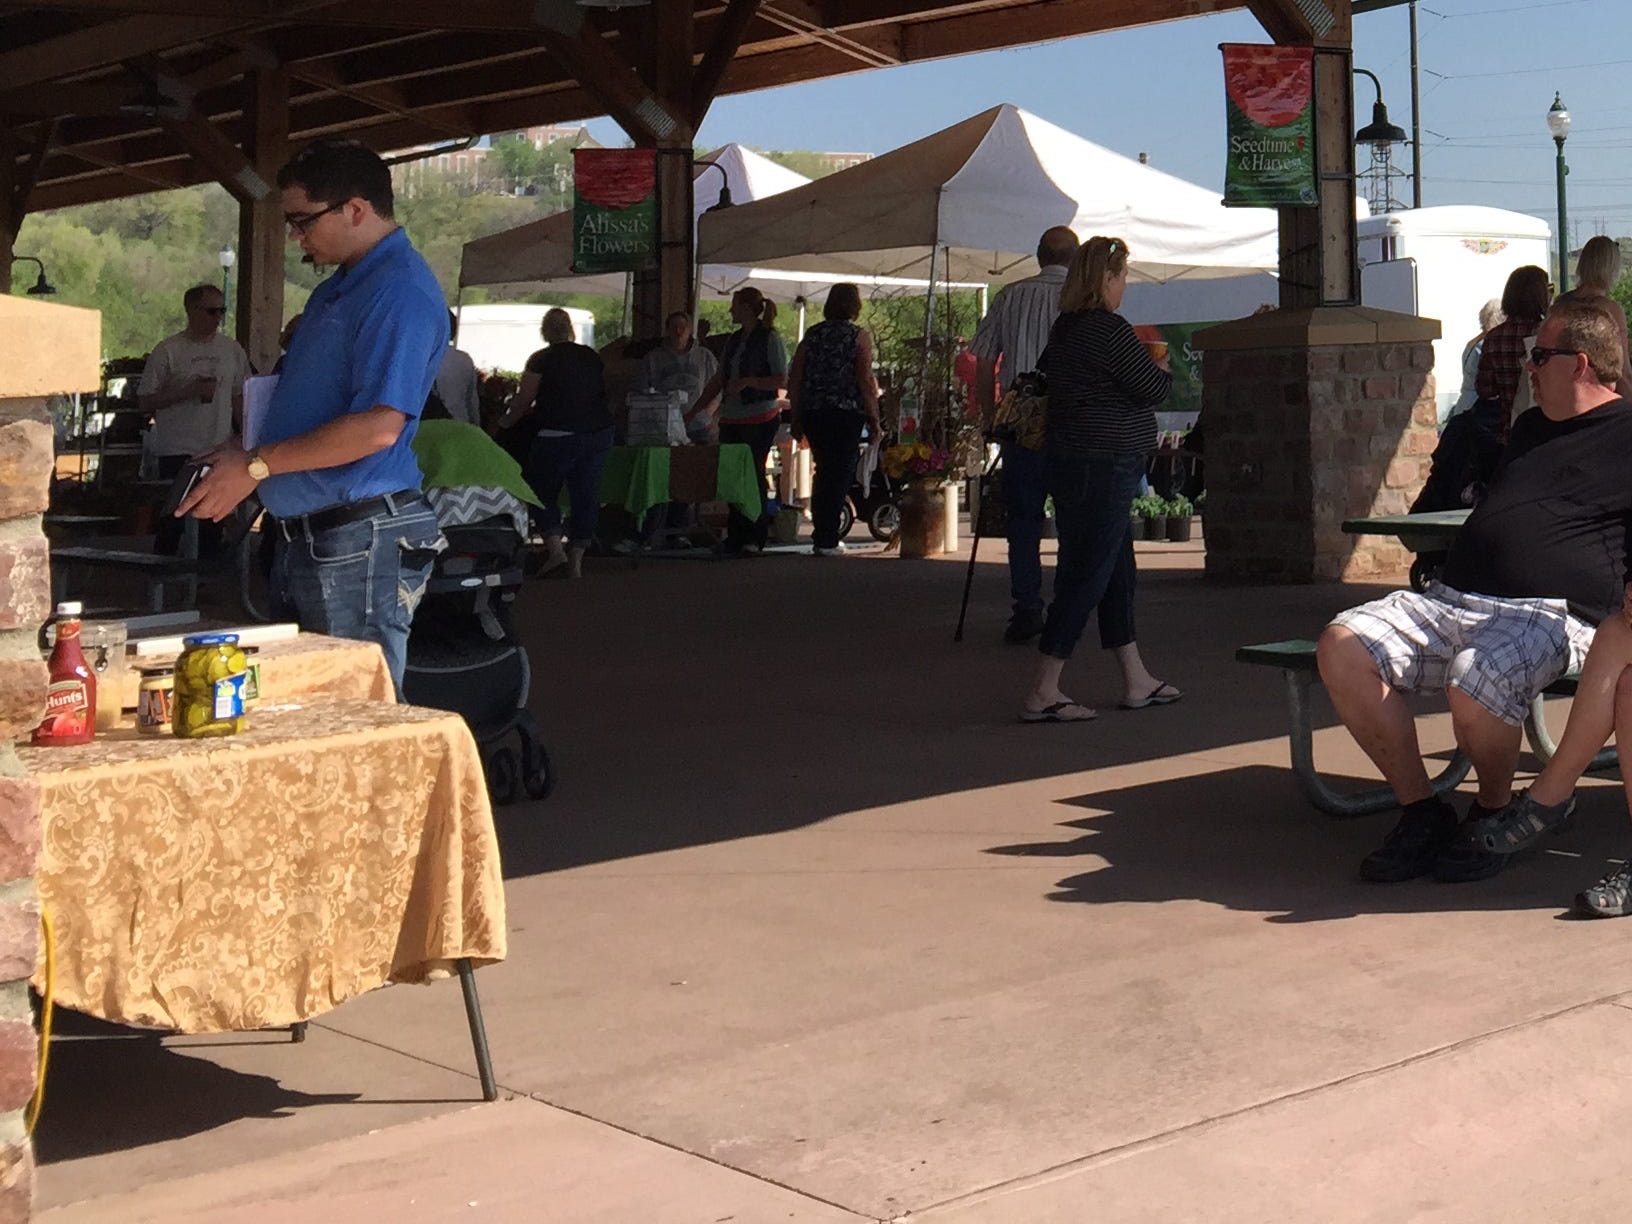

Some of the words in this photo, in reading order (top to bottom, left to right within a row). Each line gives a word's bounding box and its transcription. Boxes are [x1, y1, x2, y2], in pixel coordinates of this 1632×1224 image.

[1231, 136, 1295, 154] Seedtime
[1238, 157, 1250, 171] &
[580, 213, 649, 234] Alissa's
[580, 236, 650, 255] Flowers
